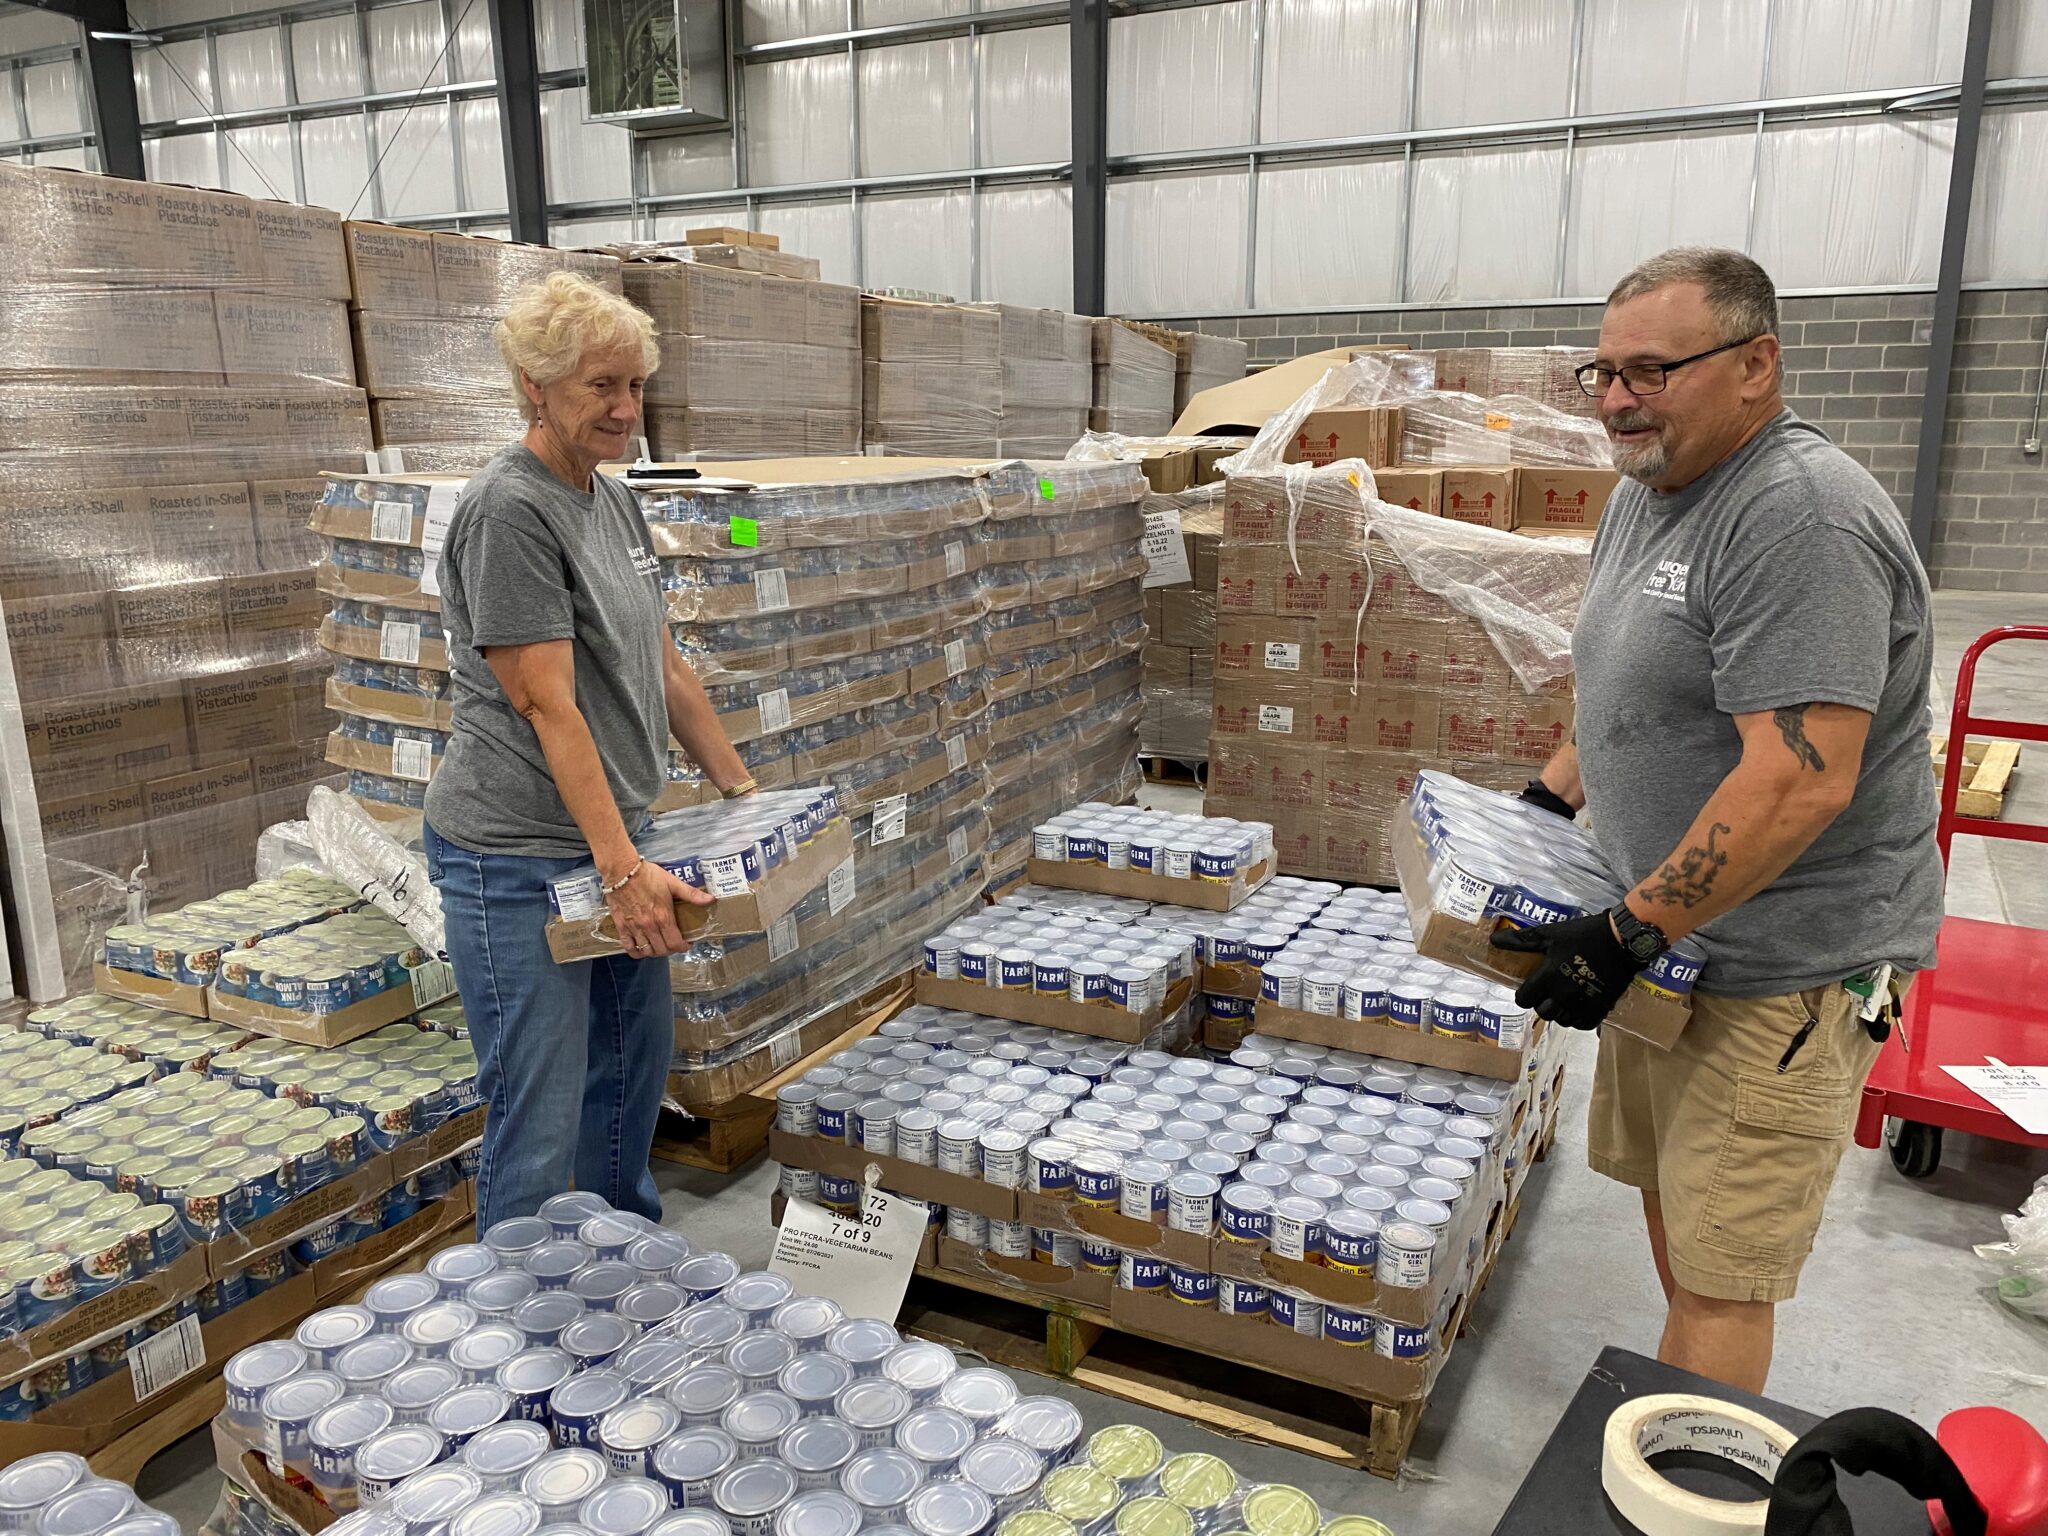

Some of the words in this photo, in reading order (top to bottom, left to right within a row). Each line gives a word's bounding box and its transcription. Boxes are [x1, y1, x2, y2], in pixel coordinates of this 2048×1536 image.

[157, 196, 205, 213] Roasted
[208, 203, 251, 219] In-Shell
[159, 211, 219, 228] Pistachios
[256, 210, 302, 227] Roasted
[258, 223, 312, 241] Pistachios
[354, 231, 397, 247] Roasted
[1302, 451, 1334, 459] FRAGILE
[150, 496, 202, 511] Roasted
[204, 492, 248, 507] In-Shell
[1455, 510, 1489, 518] FRAGILE
[1548, 506, 1582, 514] FRAGILE
[1235, 522, 1270, 530] FRAGILE
[229, 583, 275, 599] Roasted
[278, 578, 317, 594] In-Shell
[229, 595, 288, 611] Pistachios
[194, 683, 244, 699] Roasted
[247, 673, 289, 690] In-Shell
[196, 690, 258, 711] Pistachios
[45, 706, 106, 725] Roasted
[46, 717, 122, 740] Pistachios
[151, 786, 203, 804] Roasted
[207, 771, 250, 792] In-Shell
[153, 794, 217, 815] Pistachios
[1070, 842, 1093, 852] FARM
[711, 858, 737, 868] FARMER
[718, 865, 733, 873] GIRL
[1458, 874, 1488, 892] FARMER
[1460, 884, 1477, 897] GIRL
[1512, 892, 1568, 923] ARMER
[1217, 943, 1243, 954] FARM
[961, 958, 983, 971] GIRL
[1004, 966, 1031, 977] FARM
[1211, 999, 1244, 1012] ARMER
[1392, 1001, 1418, 1016] GIRL
[818, 1114, 842, 1128] GIRL
[1238, 1217, 1269, 1230] GIRL
[1277, 1219, 1299, 1231] FARMER
[1280, 1226, 1295, 1236] GIRL
[831, 1223, 841, 1235] 7
[844, 1228, 859, 1240] of
[862, 1231, 871, 1243] 9
[779, 1242, 804, 1253] Received:
[784, 1227, 800, 1236] PRO
[800, 1231, 868, 1254] FFCRA-VEGETARIAN
[869, 1249, 893, 1260] BEANS
[1080, 1241, 1119, 1257] ARMER
[1326, 1234, 1359, 1255] RMER
[777, 1249, 798, 1259] Expires:
[1337, 1251, 1360, 1260] BRAND
[775, 1255, 800, 1267] Category:
[802, 1262, 821, 1270] FFCRA
[49, 1318, 91, 1342] CANNED
[93, 1305, 117, 1323] PINK
[119, 1286, 158, 1308] SALMON
[79, 1306, 98, 1319] DEEP
[100, 1296, 114, 1308] SEA
[1327, 1313, 1371, 1332] FARME
[1398, 1334, 1430, 1347] FARM
[606, 1450, 637, 1463] FARMER
[611, 1460, 631, 1471] GIRL
